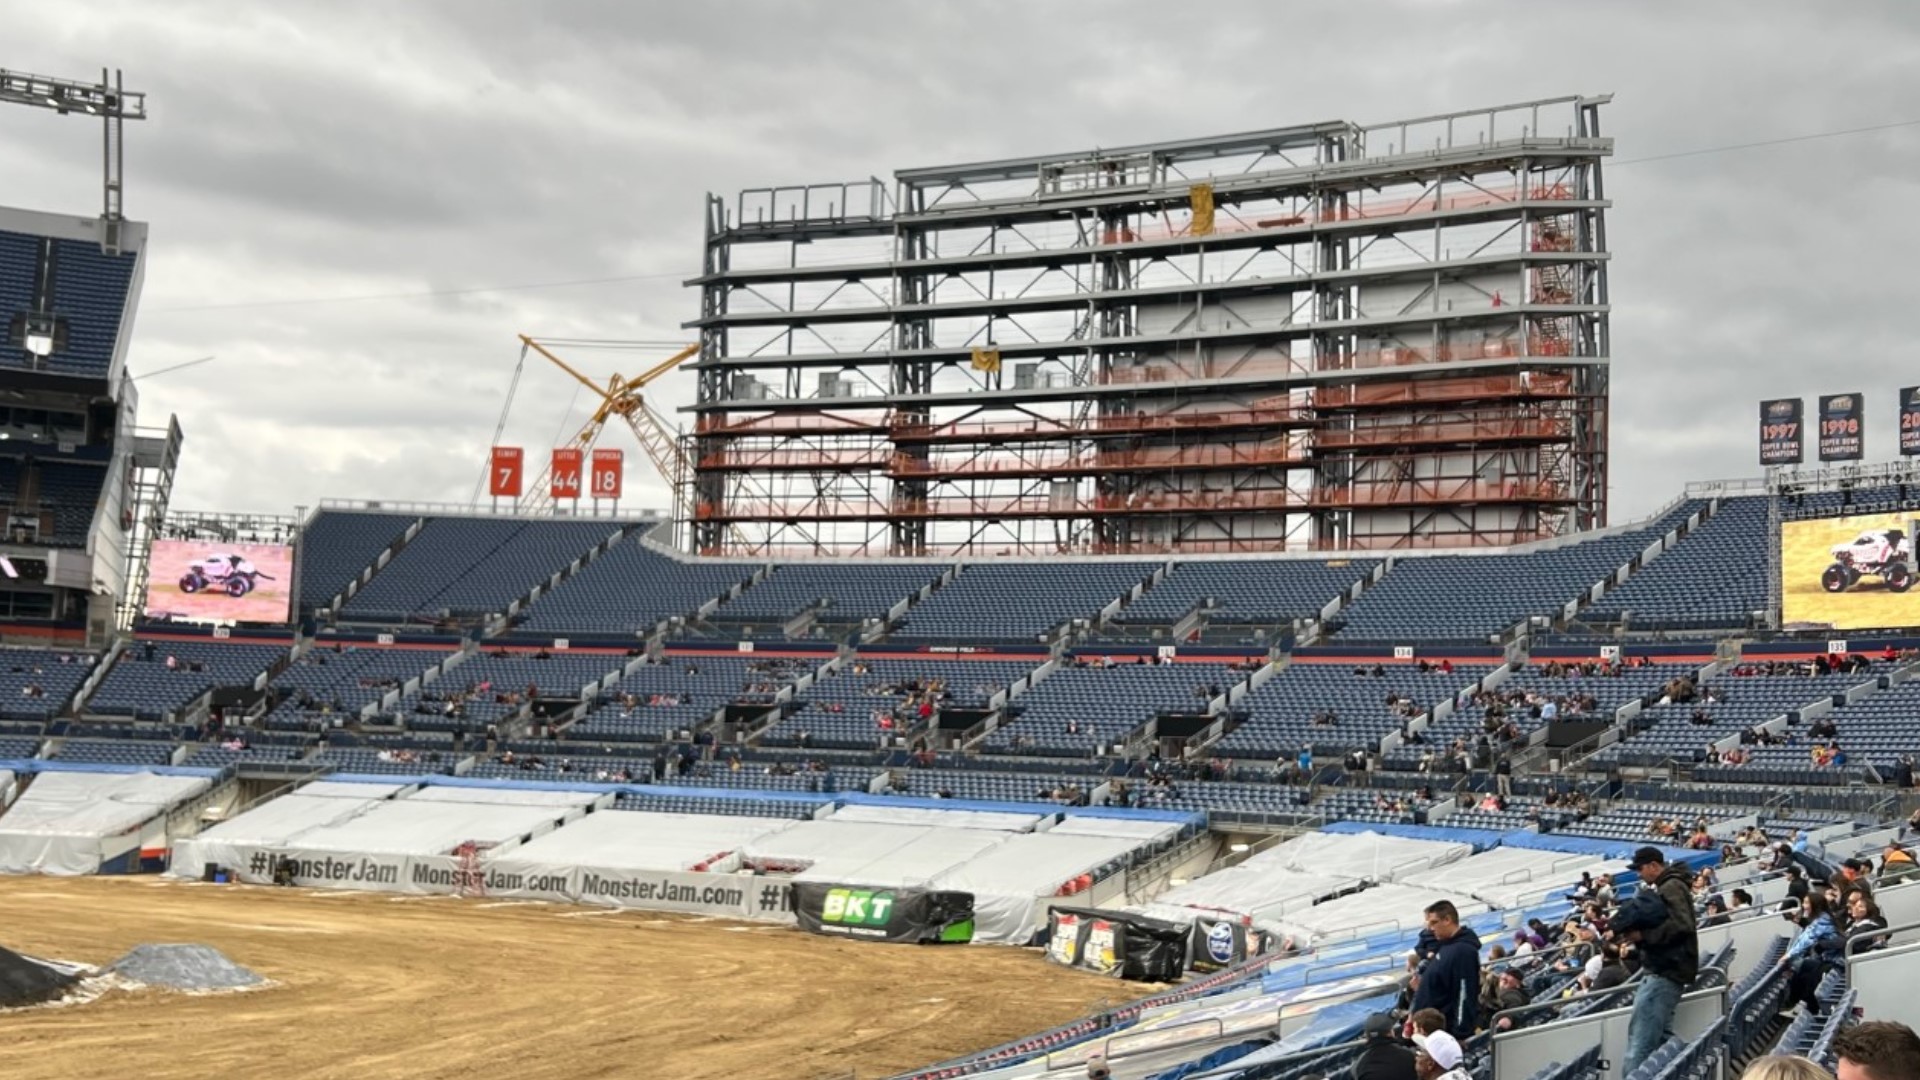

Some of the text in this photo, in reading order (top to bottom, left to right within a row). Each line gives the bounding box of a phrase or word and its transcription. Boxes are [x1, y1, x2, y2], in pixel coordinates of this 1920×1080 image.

[1763, 423, 1797, 440] 1997
[1822, 419, 1857, 435] 1998
[1762, 441, 1799, 450] SUPER BOWL
[1821, 437, 1859, 446] SUPER BOWL
[1822, 445, 1858, 454] CHAMPIONS
[1762, 450, 1798, 458] CHAMPIONS
[499, 468, 512, 489] 7
[552, 470, 578, 490] 44
[596, 470, 616, 491] 18
[1830, 641, 1845, 652] 135
[250, 852, 397, 883] #MonsterJam
[583, 873, 743, 906] MonsterJam.com
[823, 893, 892, 919] BKT
